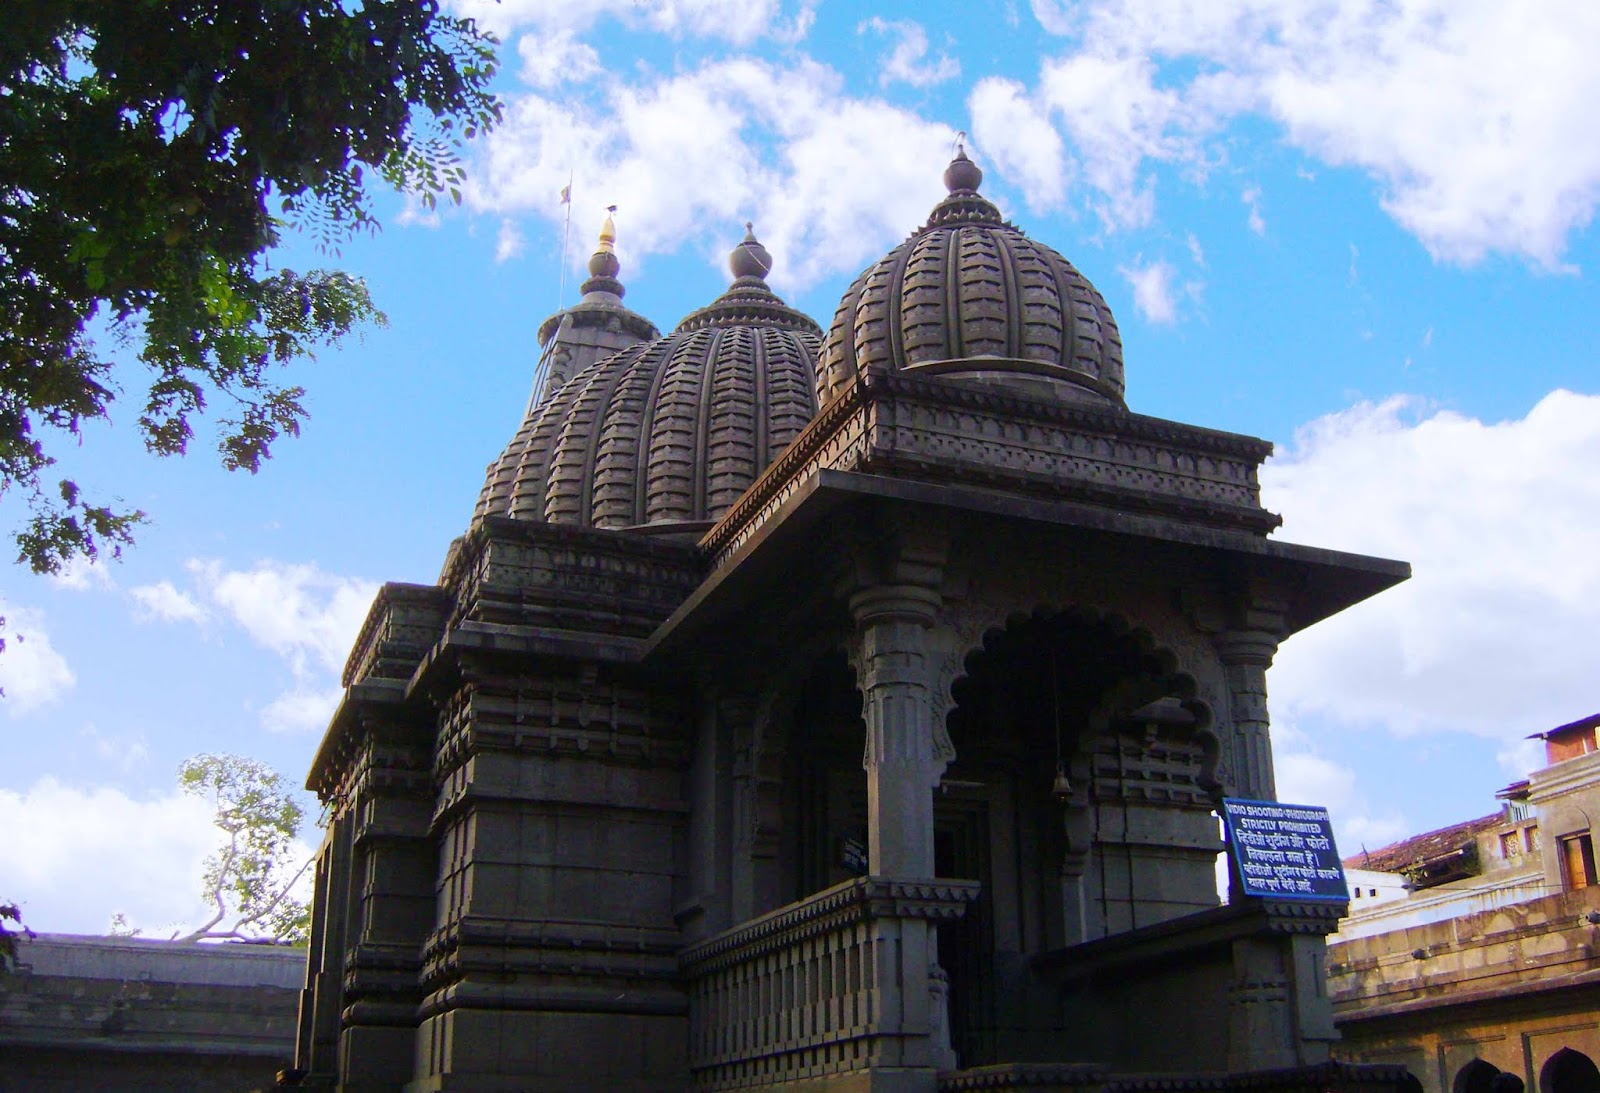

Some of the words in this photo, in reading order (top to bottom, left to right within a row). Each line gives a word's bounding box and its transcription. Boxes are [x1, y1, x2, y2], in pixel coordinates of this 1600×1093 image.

[1246, 806, 1284, 818] SHOOTING
[1241, 818, 1277, 830] STRICTLY
[1279, 821, 1322, 833] PROHIBITED
[1290, 833, 1305, 849] और
[1305, 835, 1330, 850] फोटो
